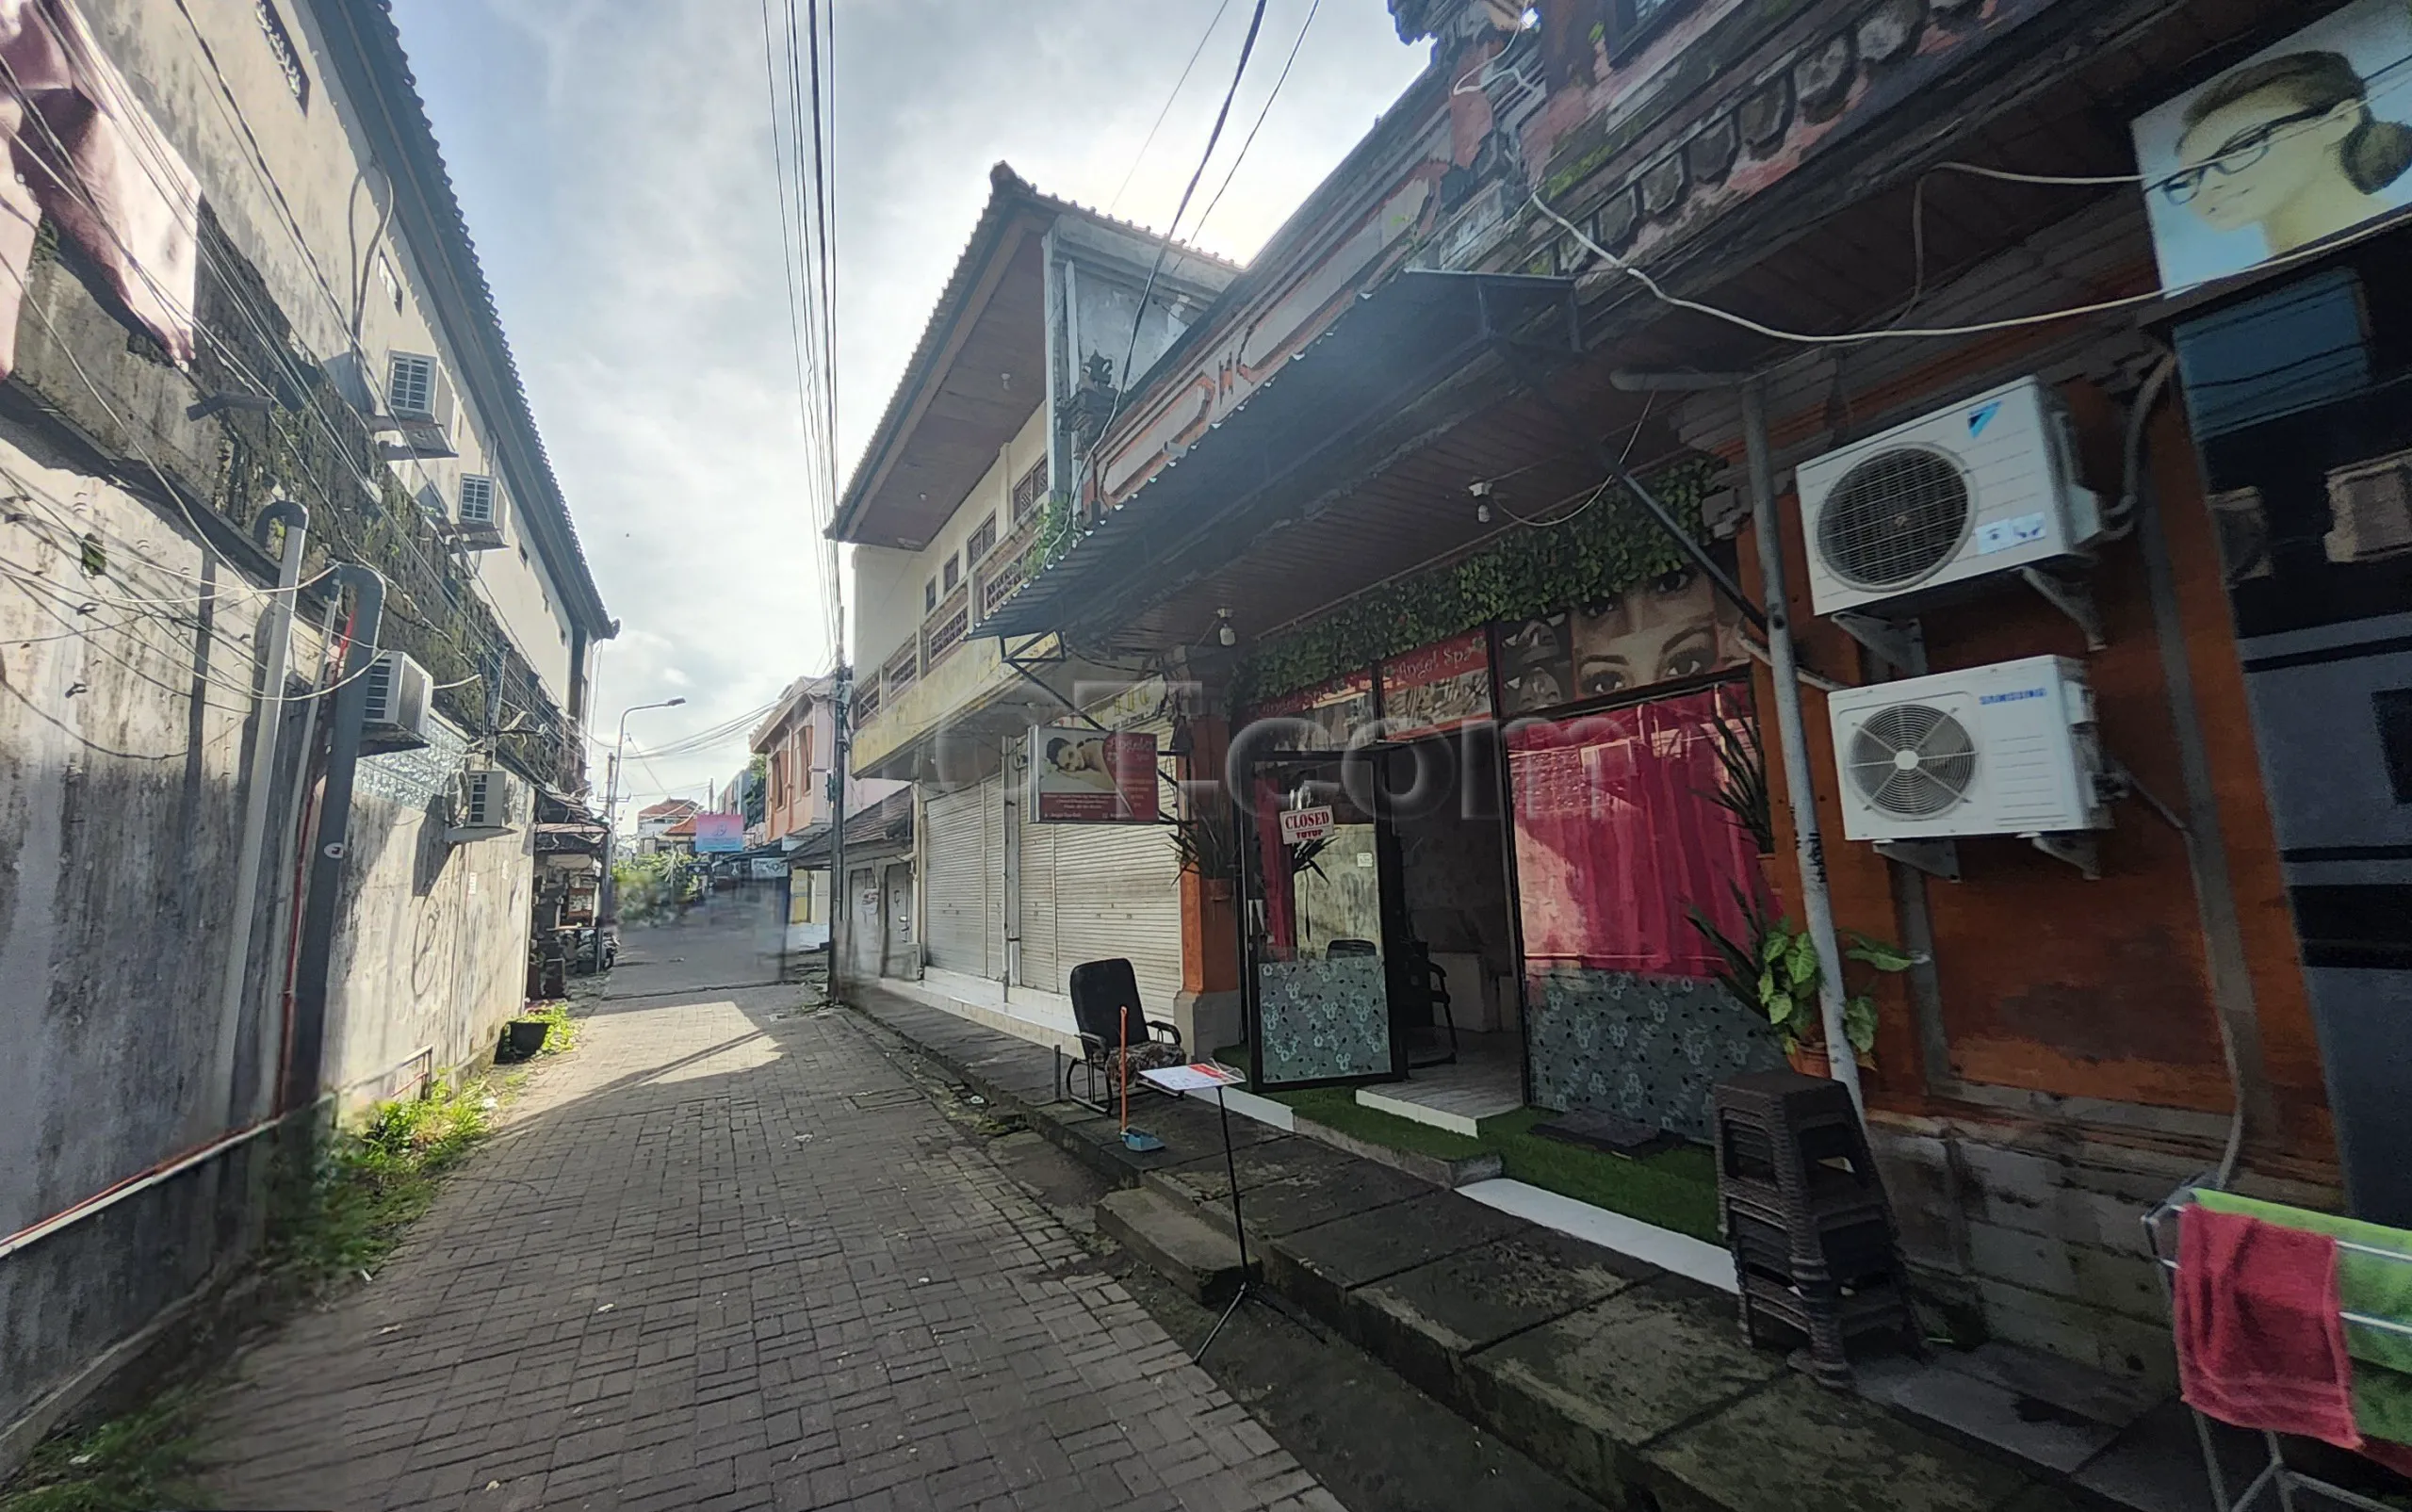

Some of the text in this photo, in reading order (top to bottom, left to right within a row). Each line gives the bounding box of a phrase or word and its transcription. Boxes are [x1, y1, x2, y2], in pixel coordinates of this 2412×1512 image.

[1397, 647, 1471, 679] Angel Spa
[1285, 811, 1330, 830] CLOSED
